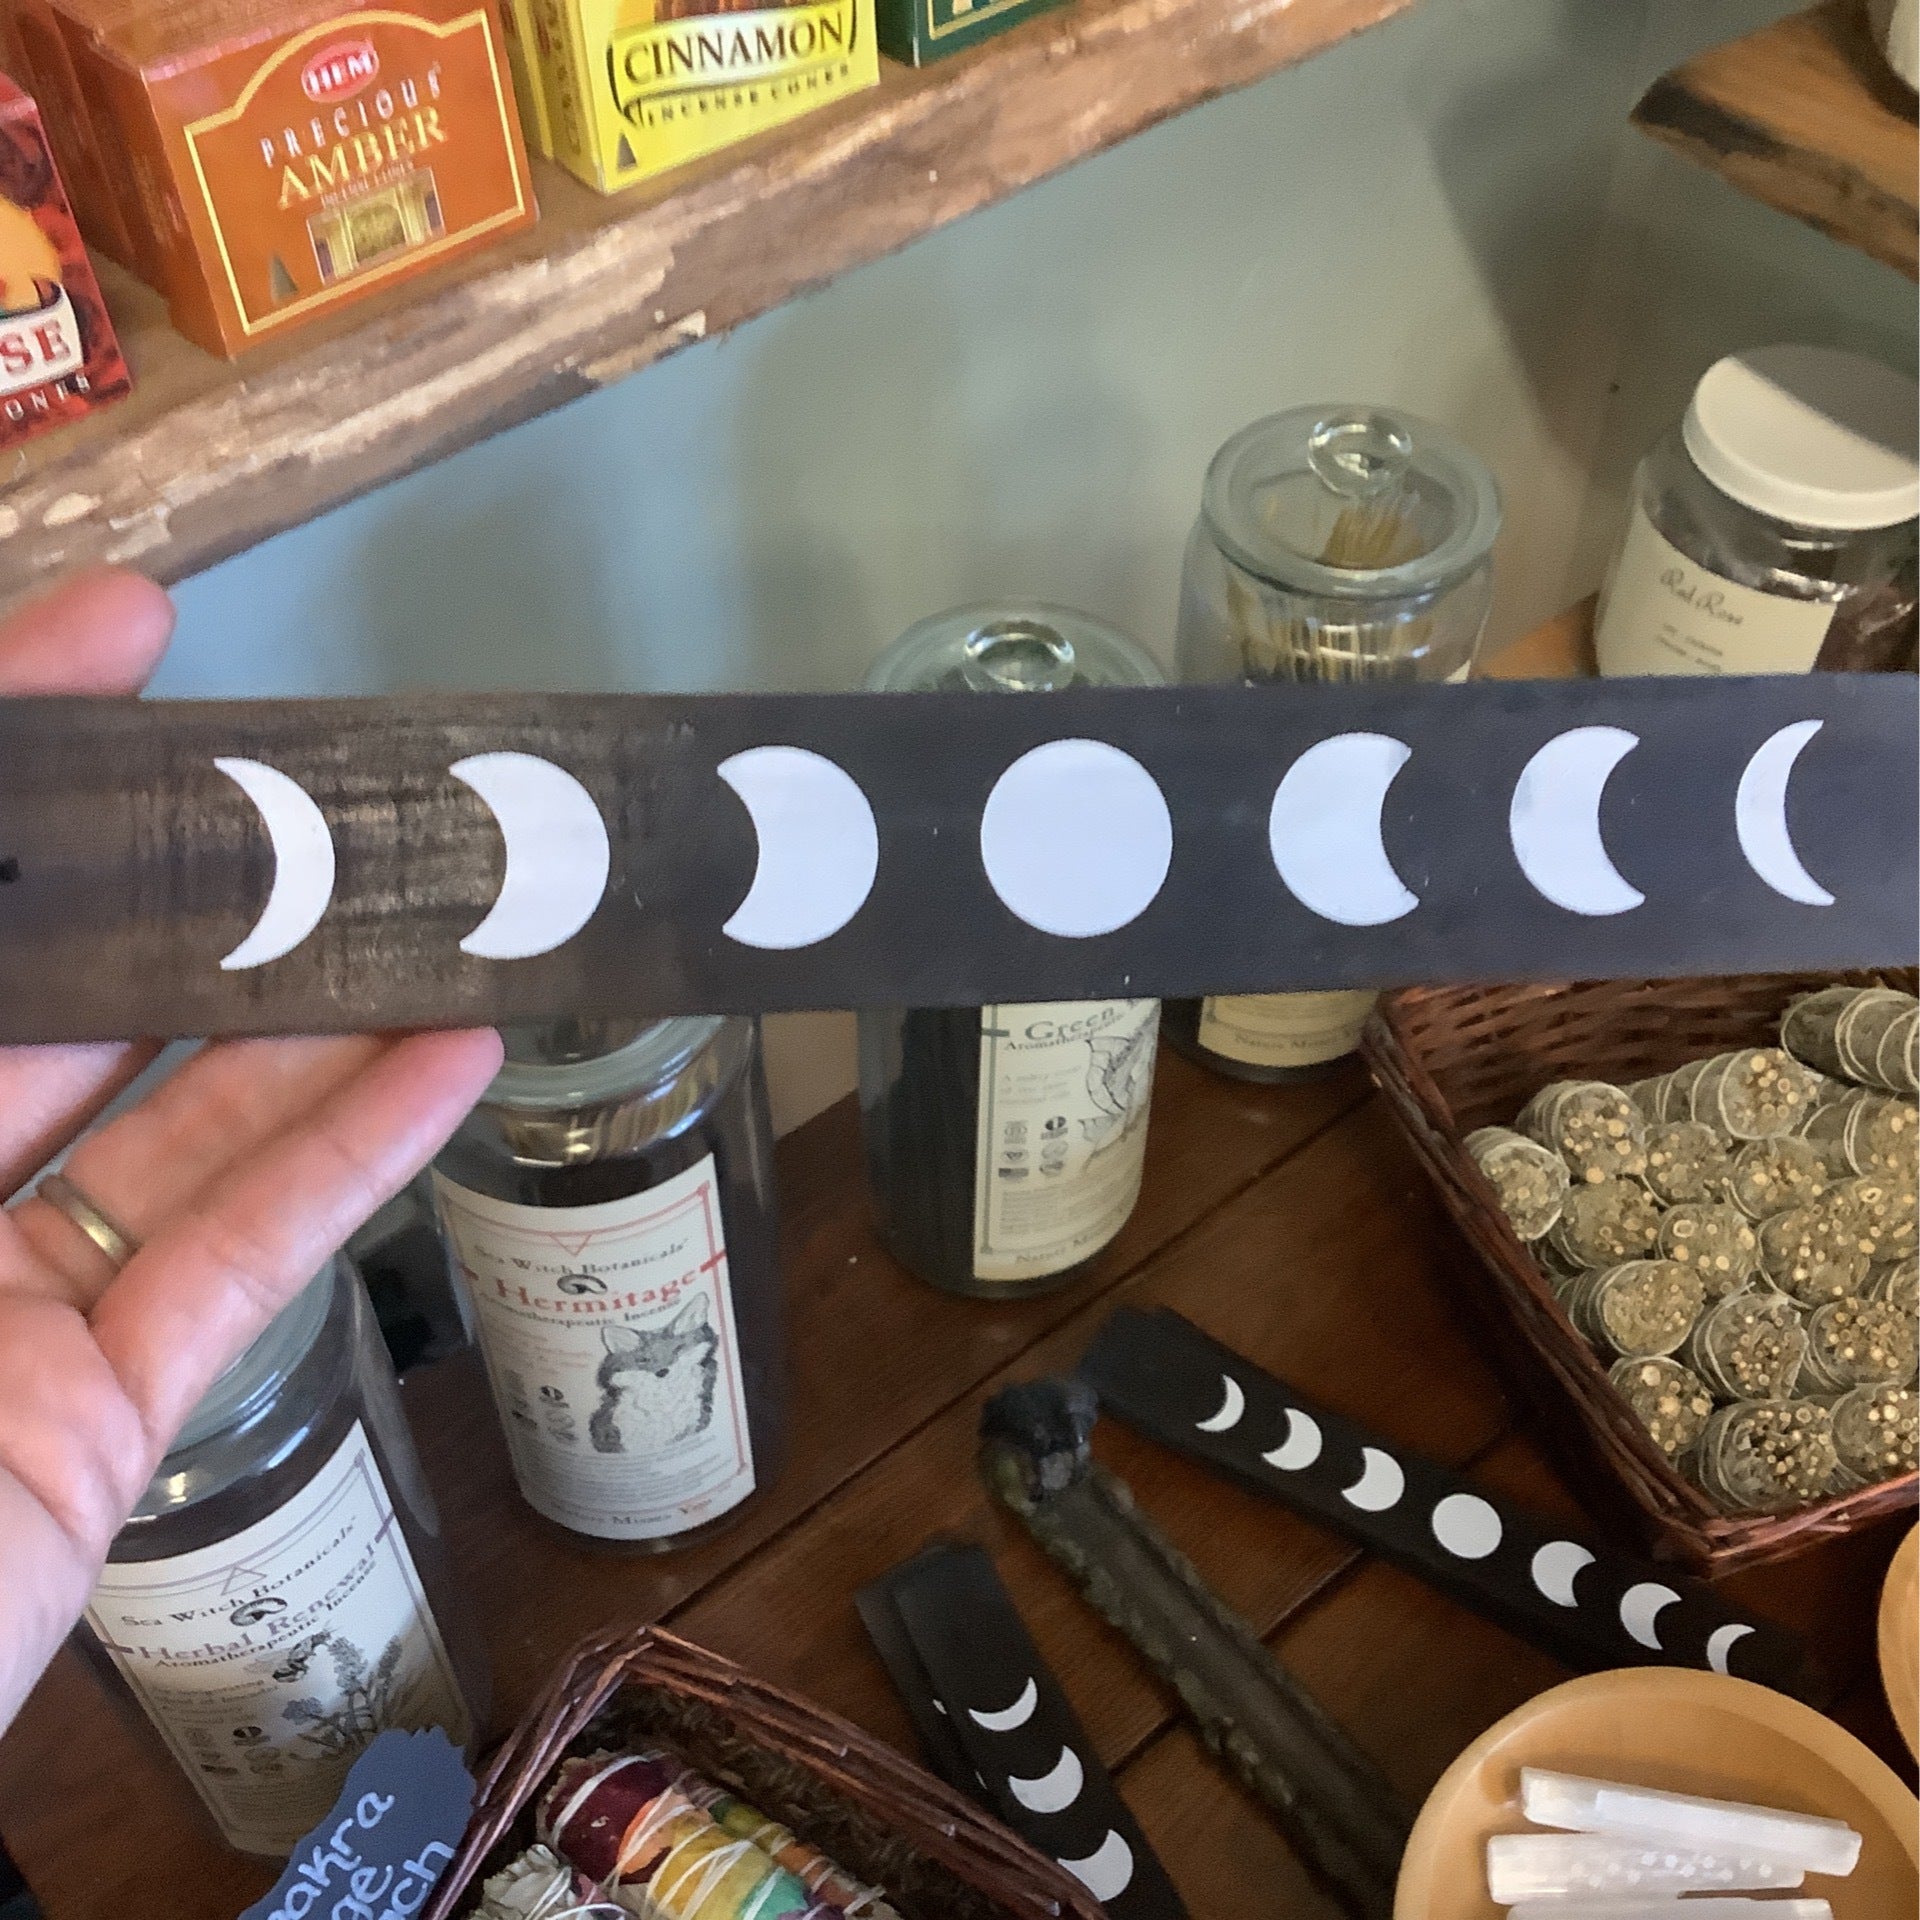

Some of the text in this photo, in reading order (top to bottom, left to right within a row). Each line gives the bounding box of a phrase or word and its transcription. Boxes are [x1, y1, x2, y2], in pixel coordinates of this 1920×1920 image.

[307, 51, 374, 95] HEM
[624, 11, 844, 84] CINNAMON
[260, 60, 442, 169] PRECIOUS
[278, 106, 448, 210] AMBER
[1024, 1006, 1115, 1041] Green
[494, 1268, 697, 1314] Hermitage
[120, 1615, 163, 1627] Sea
[169, 1598, 244, 1624] Witch
[138, 1541, 378, 1660] Herbal Renewal
